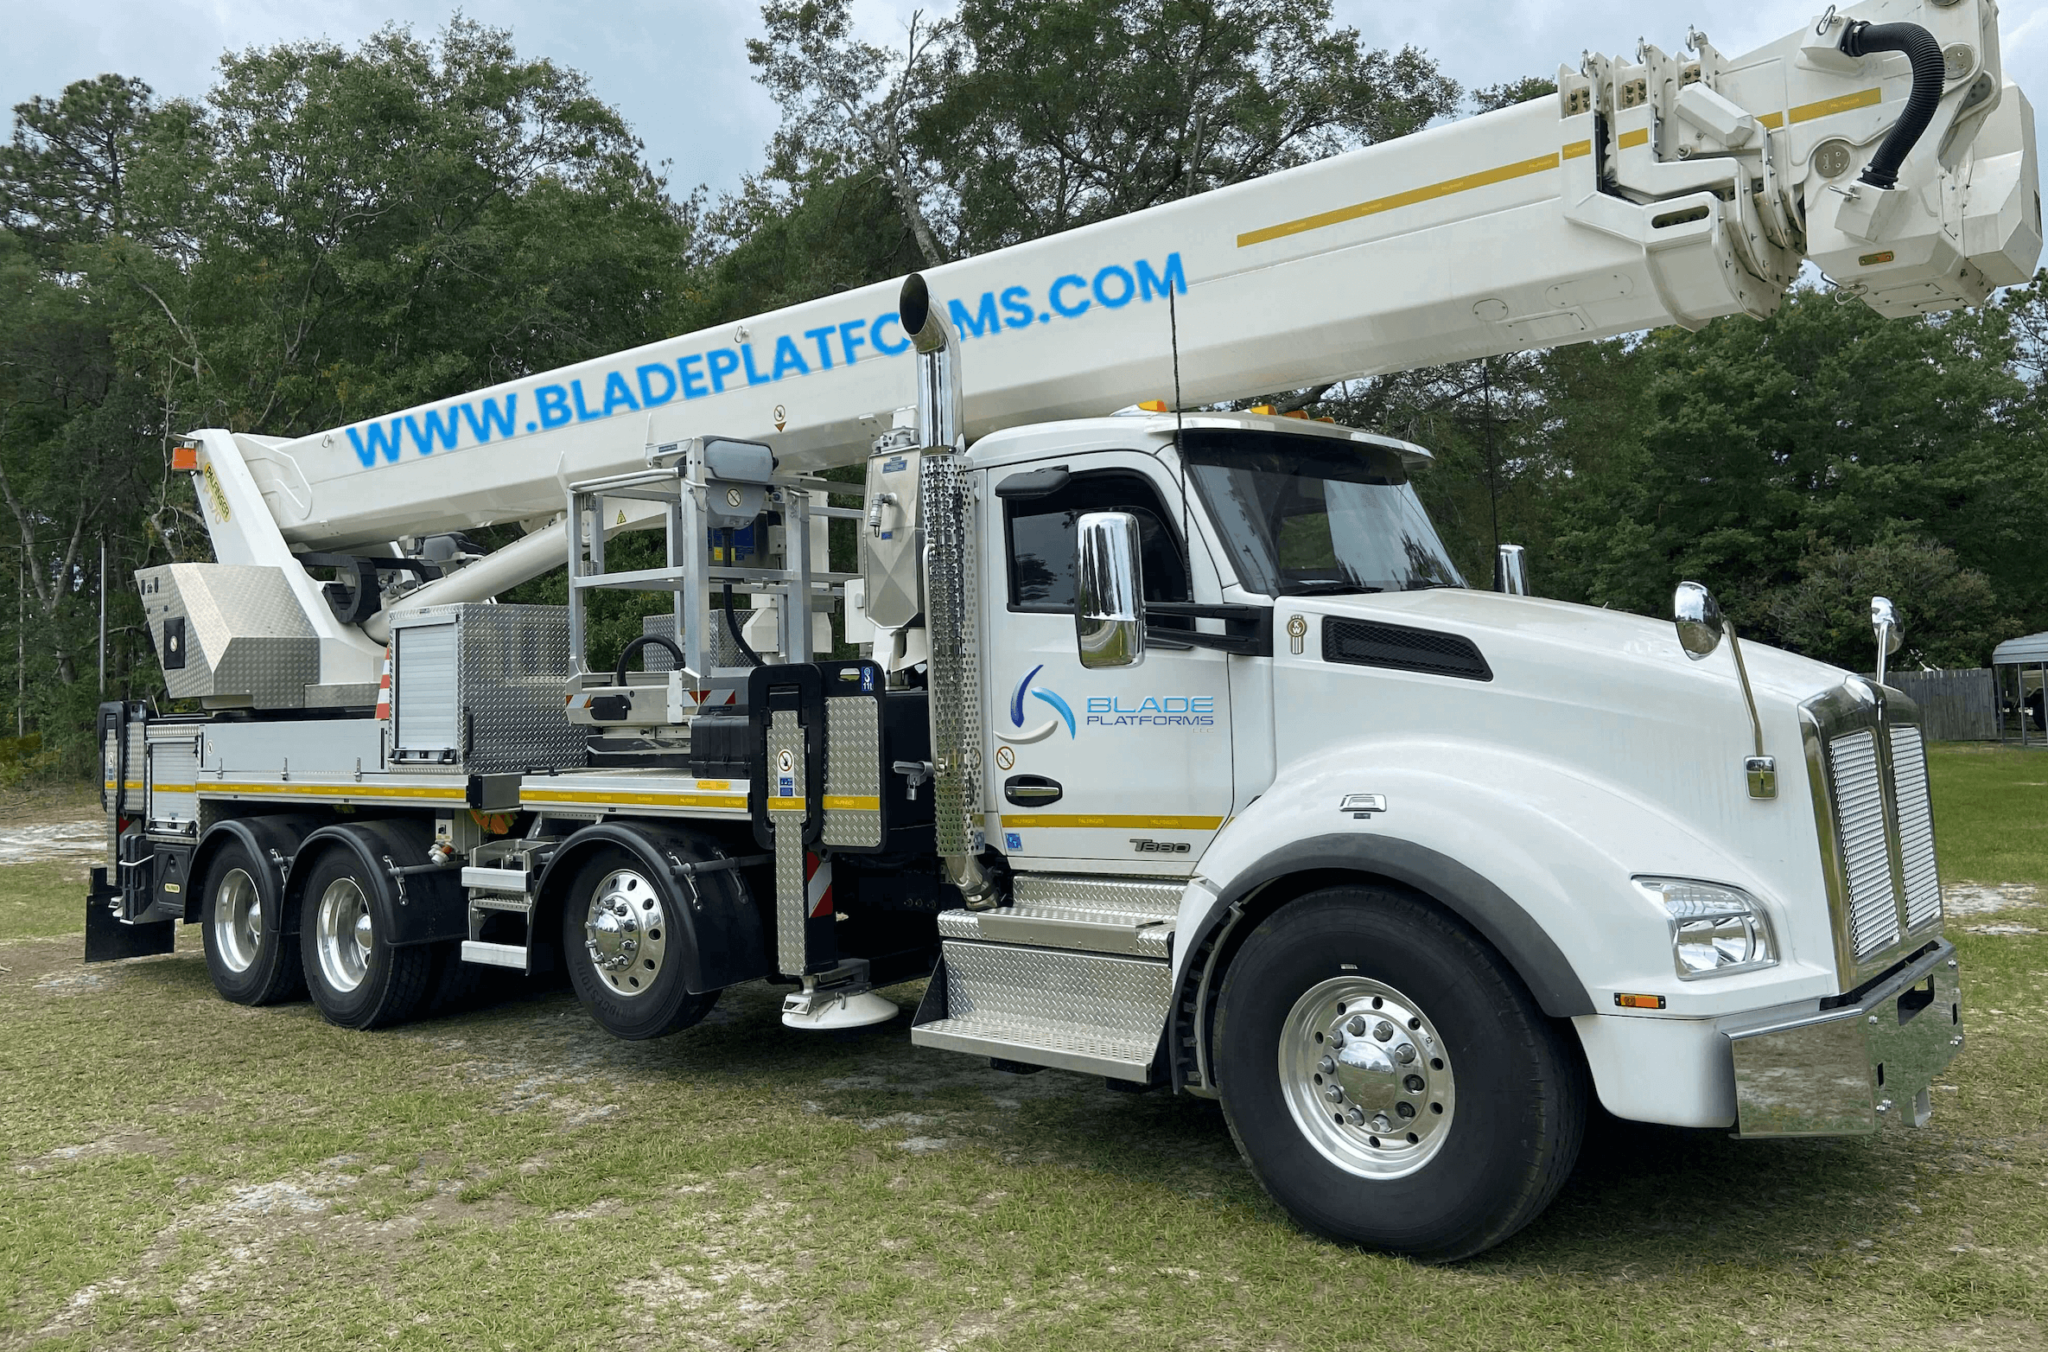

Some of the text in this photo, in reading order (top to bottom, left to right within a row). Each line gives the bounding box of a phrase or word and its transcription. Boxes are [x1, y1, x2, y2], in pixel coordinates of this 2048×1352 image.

[345, 252, 1188, 467] WWW.BLADEPLATFOMS.COM
[1086, 695, 1214, 713] BLADE
[1086, 715, 1214, 726] PLATFORMS
[1129, 838, 1191, 853] T880
